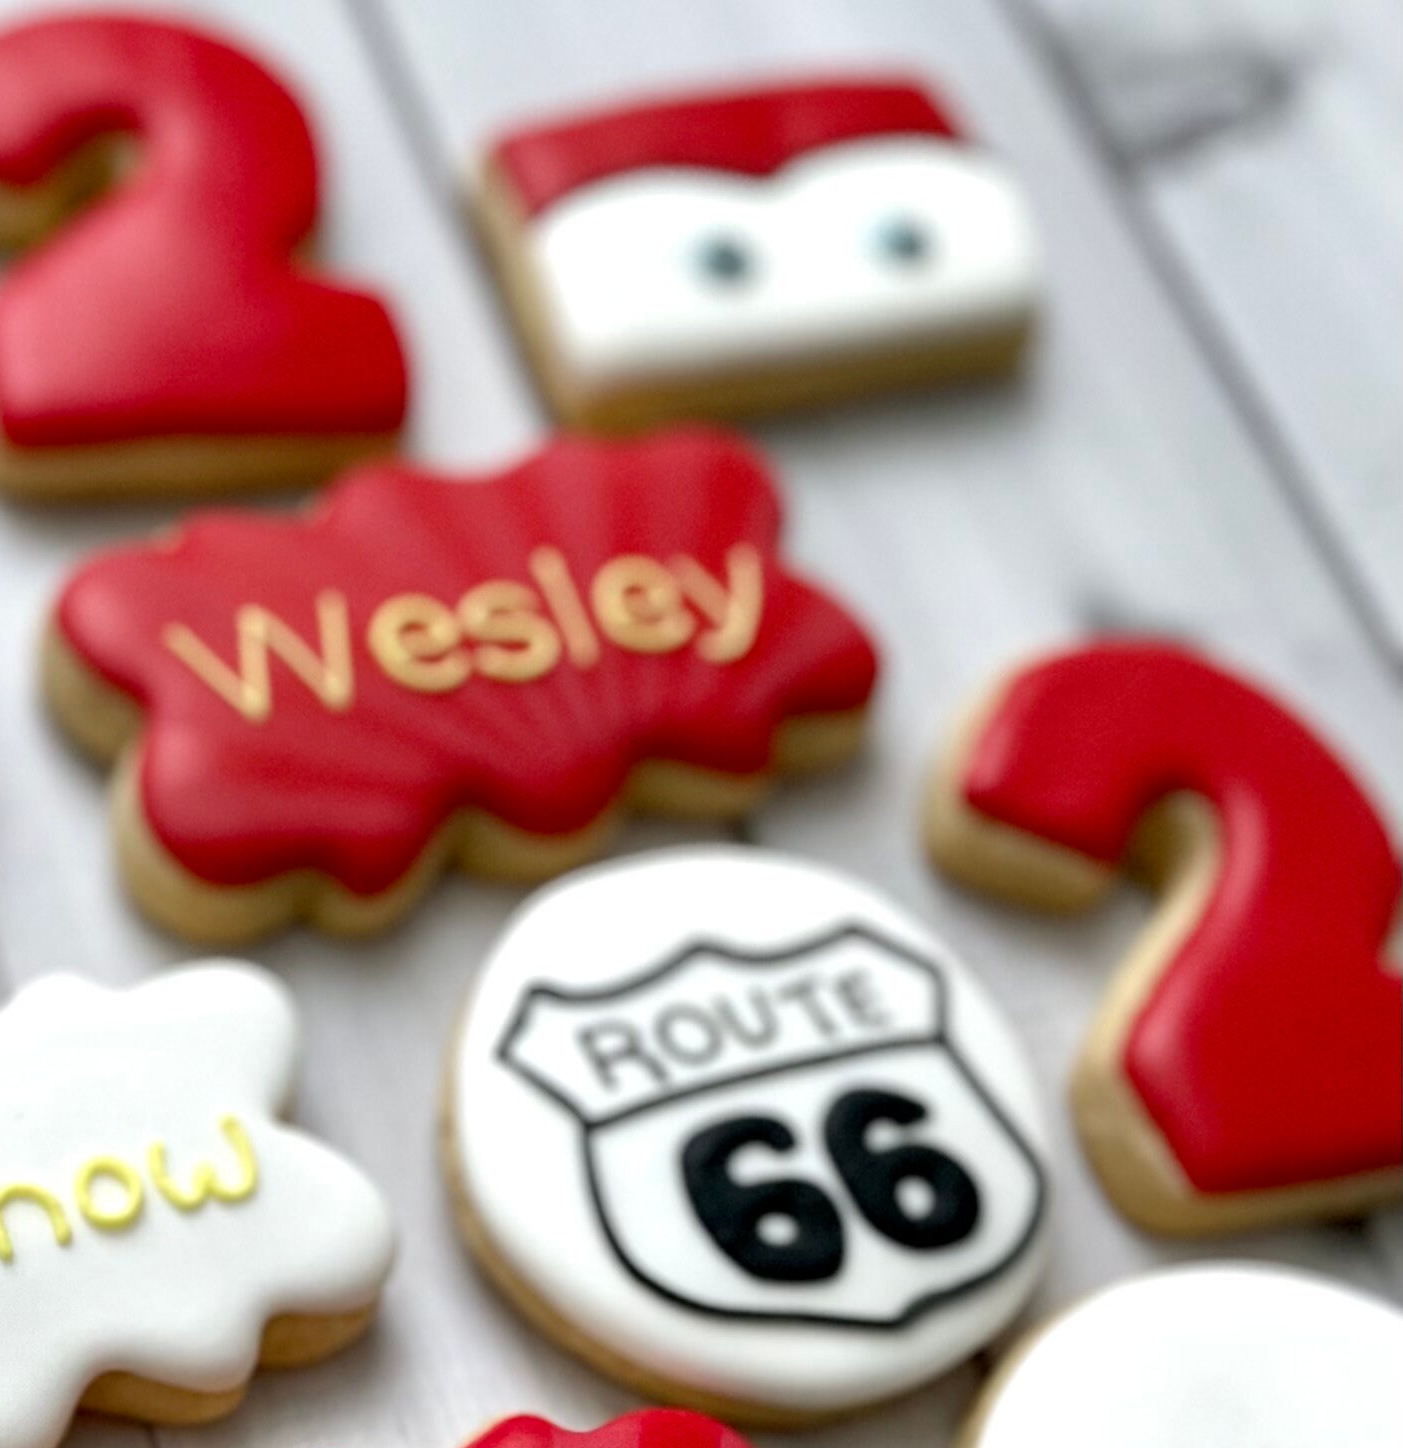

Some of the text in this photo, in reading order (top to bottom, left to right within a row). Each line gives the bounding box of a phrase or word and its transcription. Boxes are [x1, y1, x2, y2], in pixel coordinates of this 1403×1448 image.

[160, 541, 764, 725] Wesley
[576, 968, 892, 1092] ROUTE
[679, 1086, 982, 1287] 66
